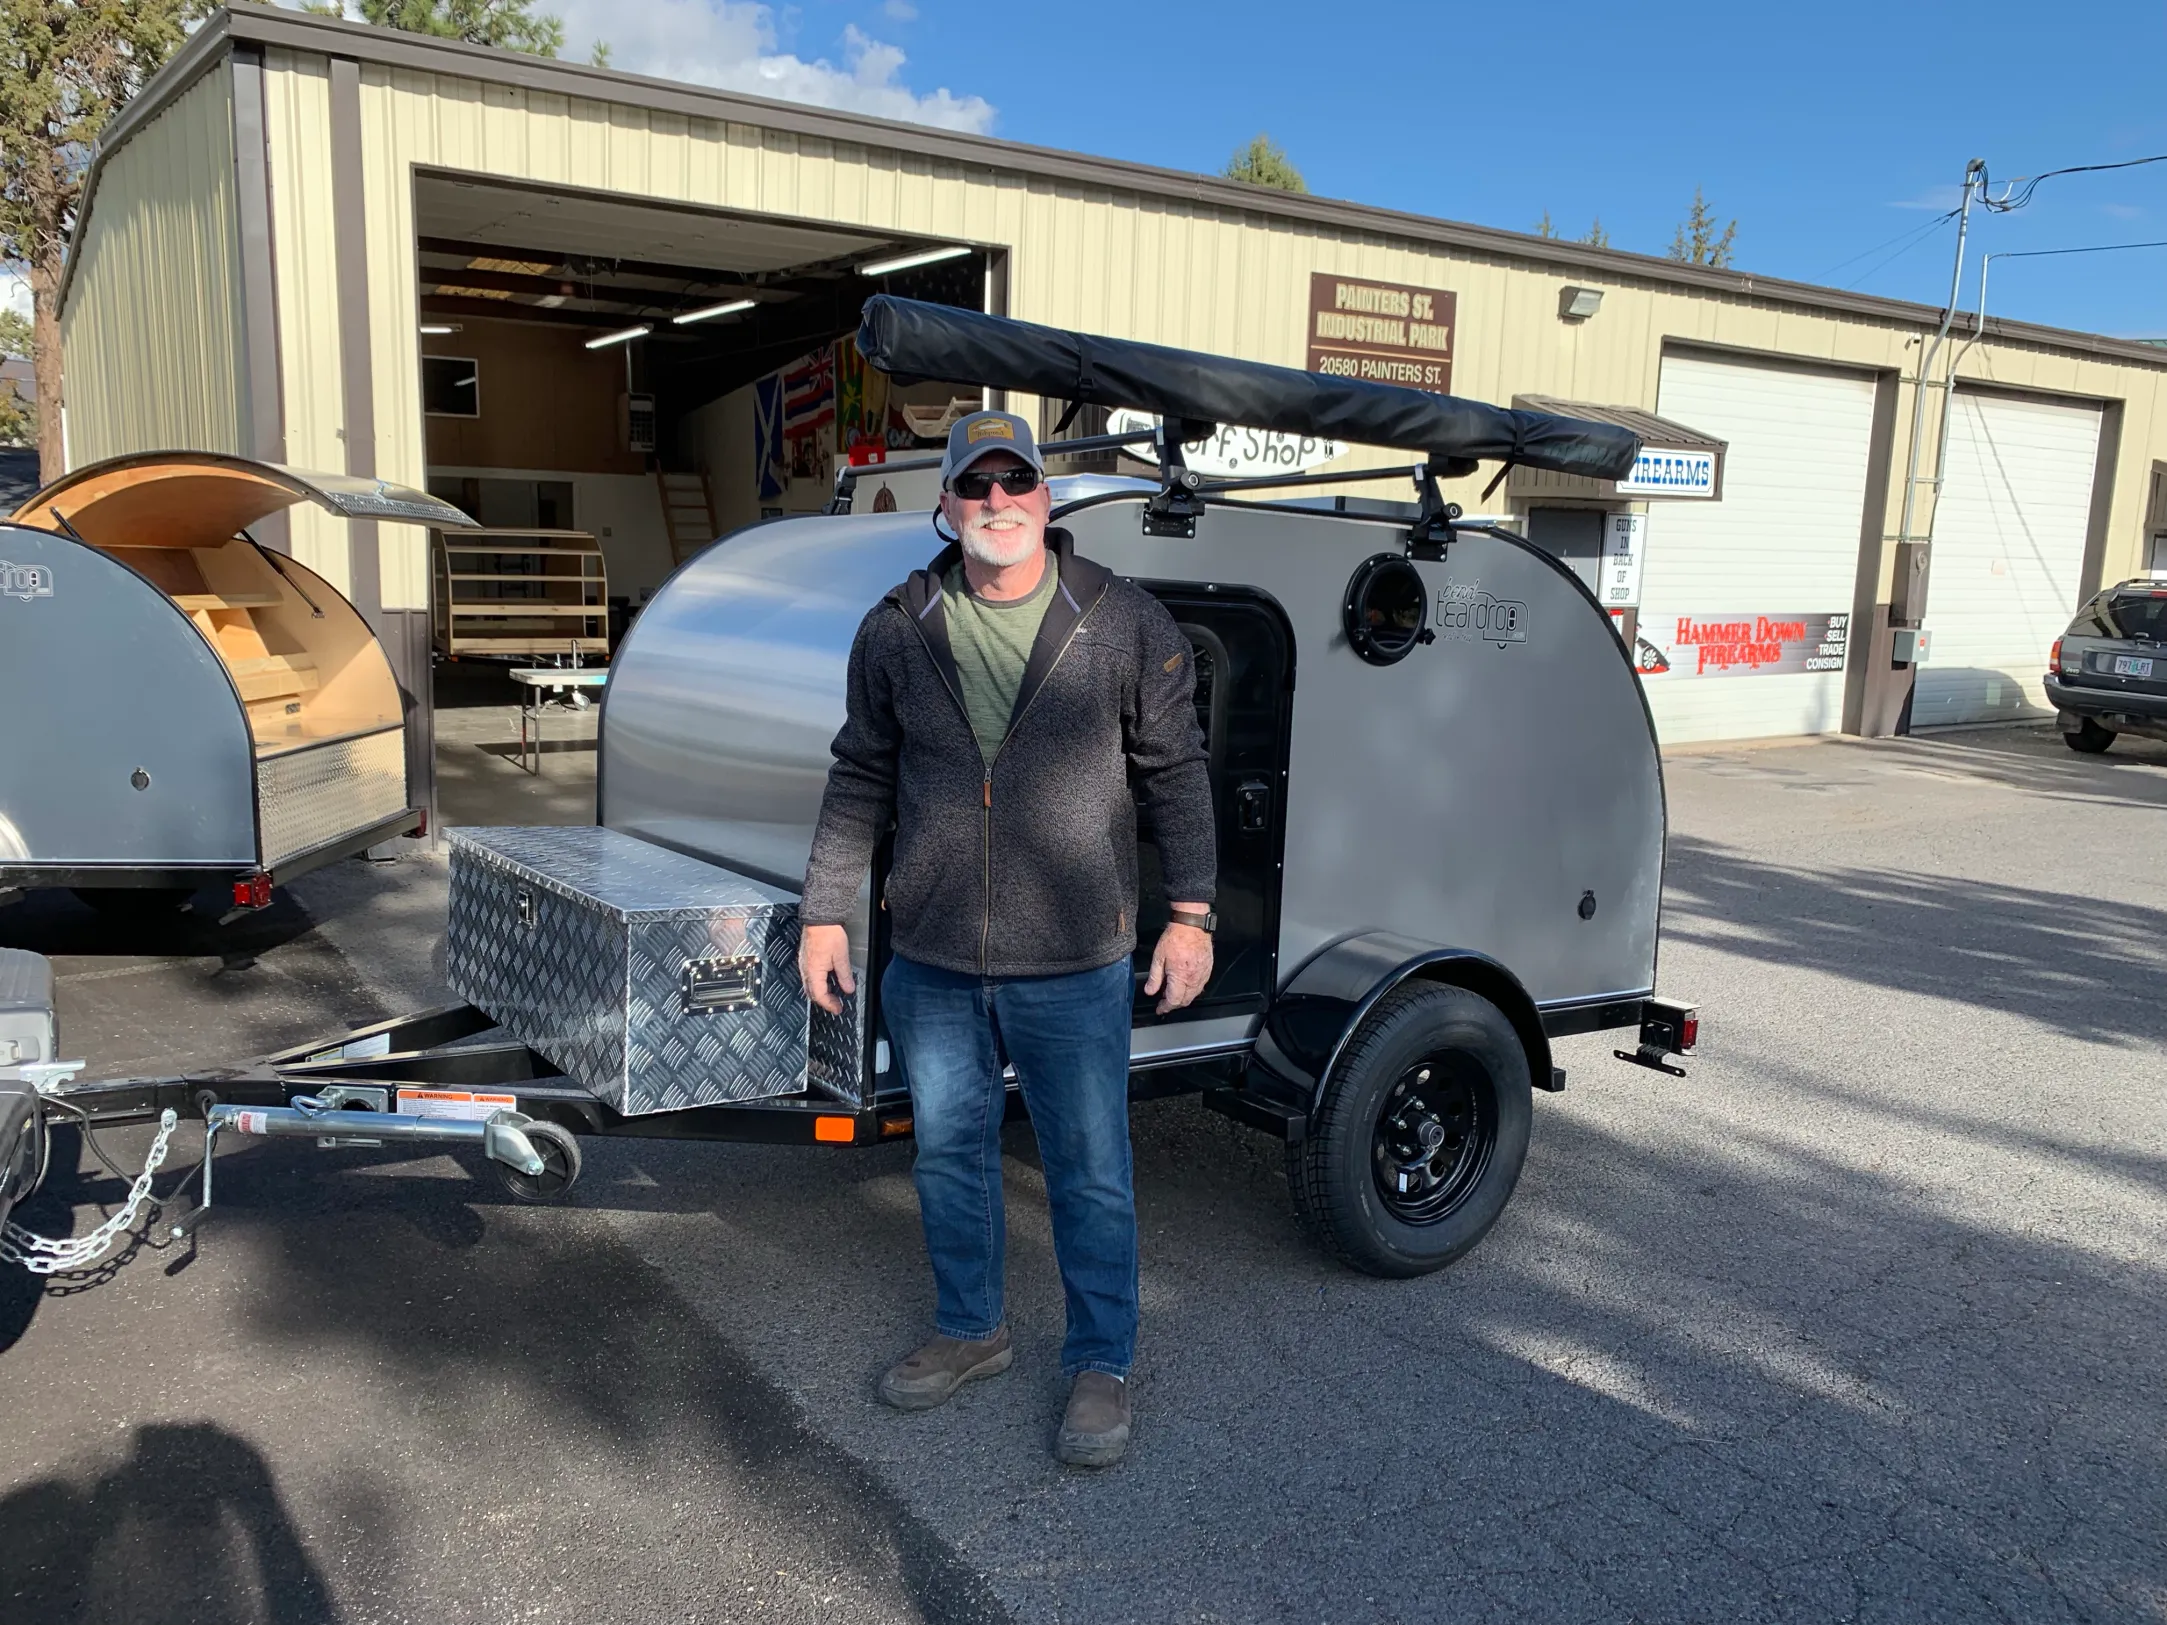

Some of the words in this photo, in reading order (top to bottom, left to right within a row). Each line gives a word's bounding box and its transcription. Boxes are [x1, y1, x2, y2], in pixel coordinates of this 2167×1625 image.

[1335, 283, 1410, 317] PAINTERS
[1413, 293, 1434, 321] ST.
[1316, 311, 1407, 346] INDUSTRIAL
[1408, 323, 1449, 351] PARK
[1319, 356, 1358, 377] 20580
[1361, 360, 1423, 383] PAINTERS
[1424, 366, 1442, 385] ST.
[1243, 427, 1316, 466] Shop
[1634, 456, 1710, 486] IREARMS
[1616, 519, 1637, 533] GUNS
[1620, 536, 1629, 549] IN
[1613, 553, 1634, 566] BACK
[1617, 570, 1627, 583] OF
[1442, 576, 1479, 601] bend
[1610, 587, 1630, 600] SHOP
[1830, 616, 1848, 629] BUY
[1676, 616, 1752, 645] HAMMER
[1755, 616, 1807, 643] DOWN
[1826, 630, 1847, 642] SELL
[1818, 643, 1844, 656] TRADE
[1806, 657, 1843, 670] CONSIGN
[2118, 659, 2131, 671] 797
